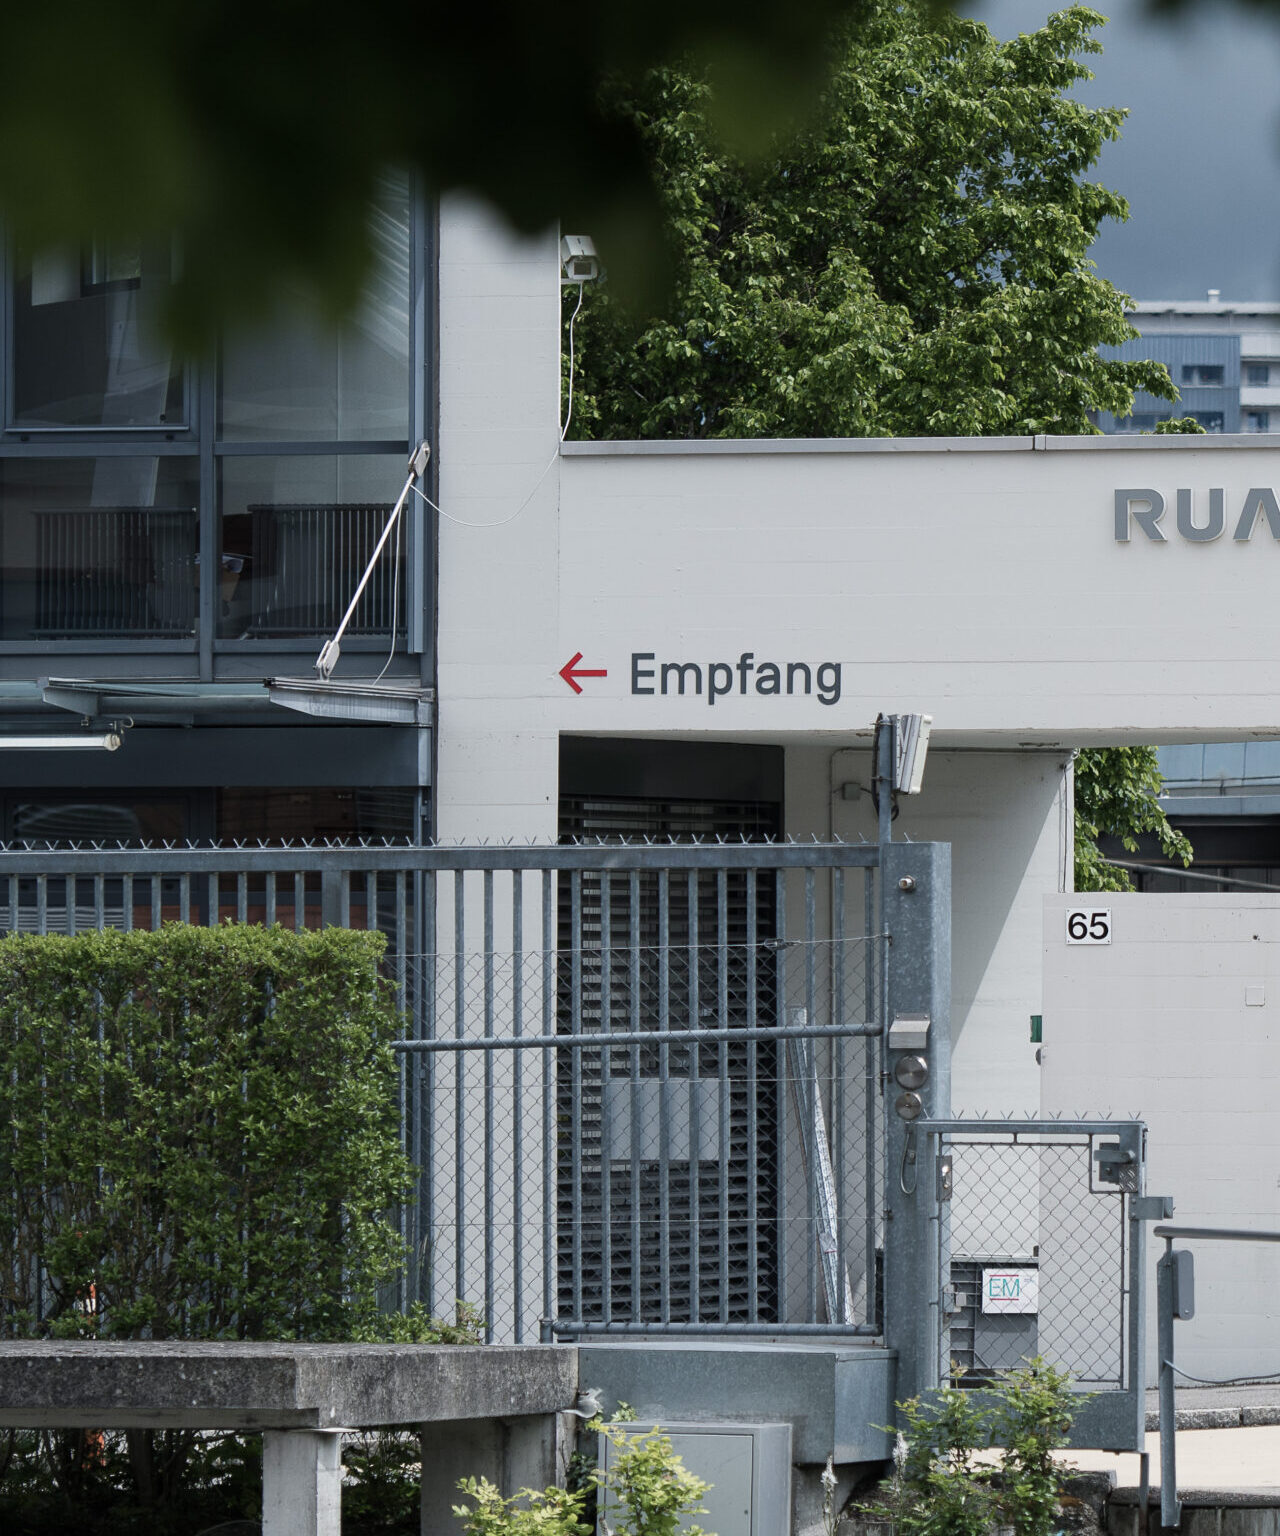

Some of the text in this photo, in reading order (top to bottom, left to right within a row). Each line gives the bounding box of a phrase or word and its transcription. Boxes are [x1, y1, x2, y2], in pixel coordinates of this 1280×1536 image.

[631, 652, 842, 705] Empfang
[1068, 912, 1109, 940] 65
[989, 1278, 1020, 1297] EM
